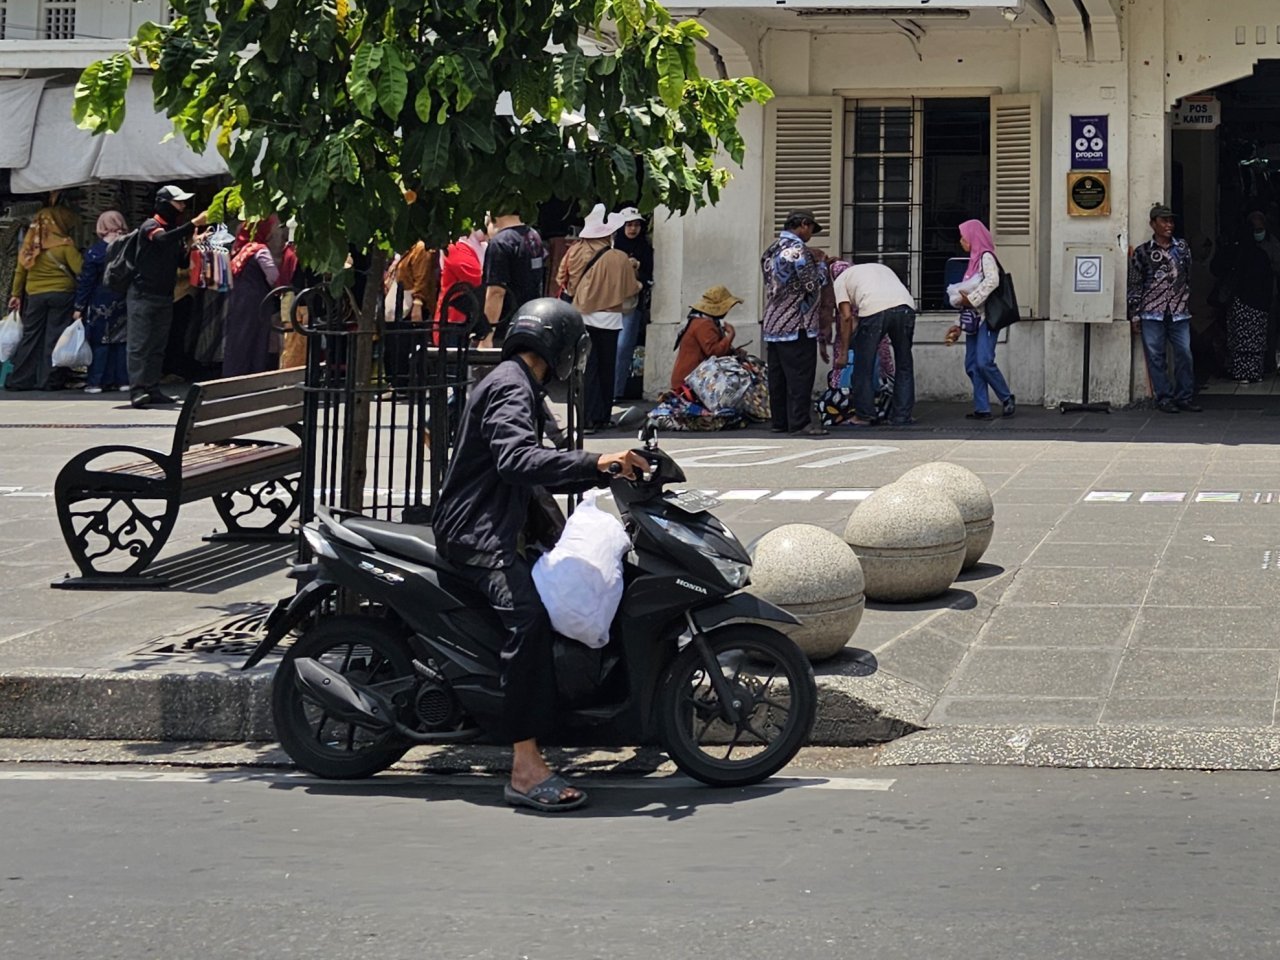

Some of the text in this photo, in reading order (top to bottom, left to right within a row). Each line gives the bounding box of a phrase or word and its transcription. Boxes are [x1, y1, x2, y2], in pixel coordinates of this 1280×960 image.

[1189, 104, 1208, 113] POS
[1183, 115, 1213, 123] KAMTIB
[1075, 151, 1104, 159] propan
[675, 578, 708, 595] HONDA
